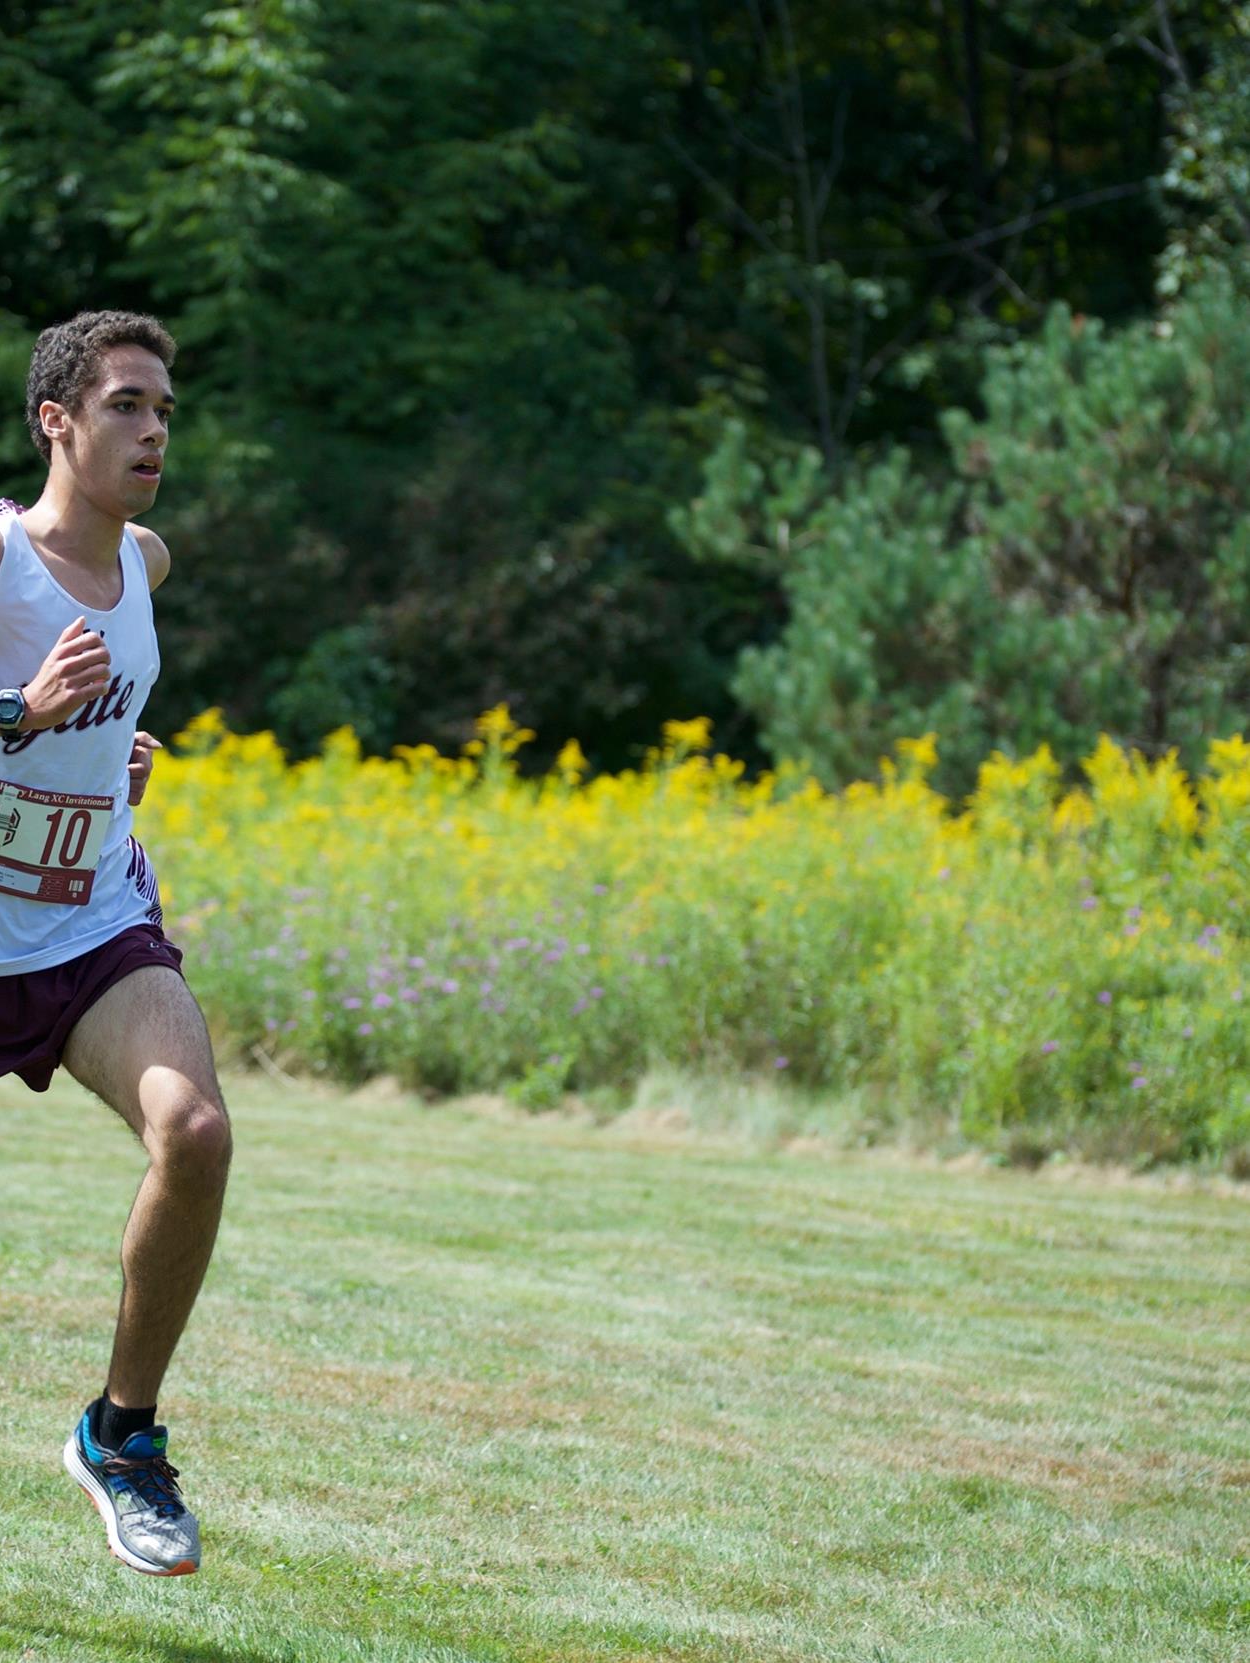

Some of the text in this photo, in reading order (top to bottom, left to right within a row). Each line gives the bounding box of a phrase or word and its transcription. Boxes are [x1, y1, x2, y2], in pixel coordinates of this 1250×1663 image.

[28, 790, 51, 803] Lang
[51, 794, 66, 804] XC
[40, 808, 92, 867] 10
